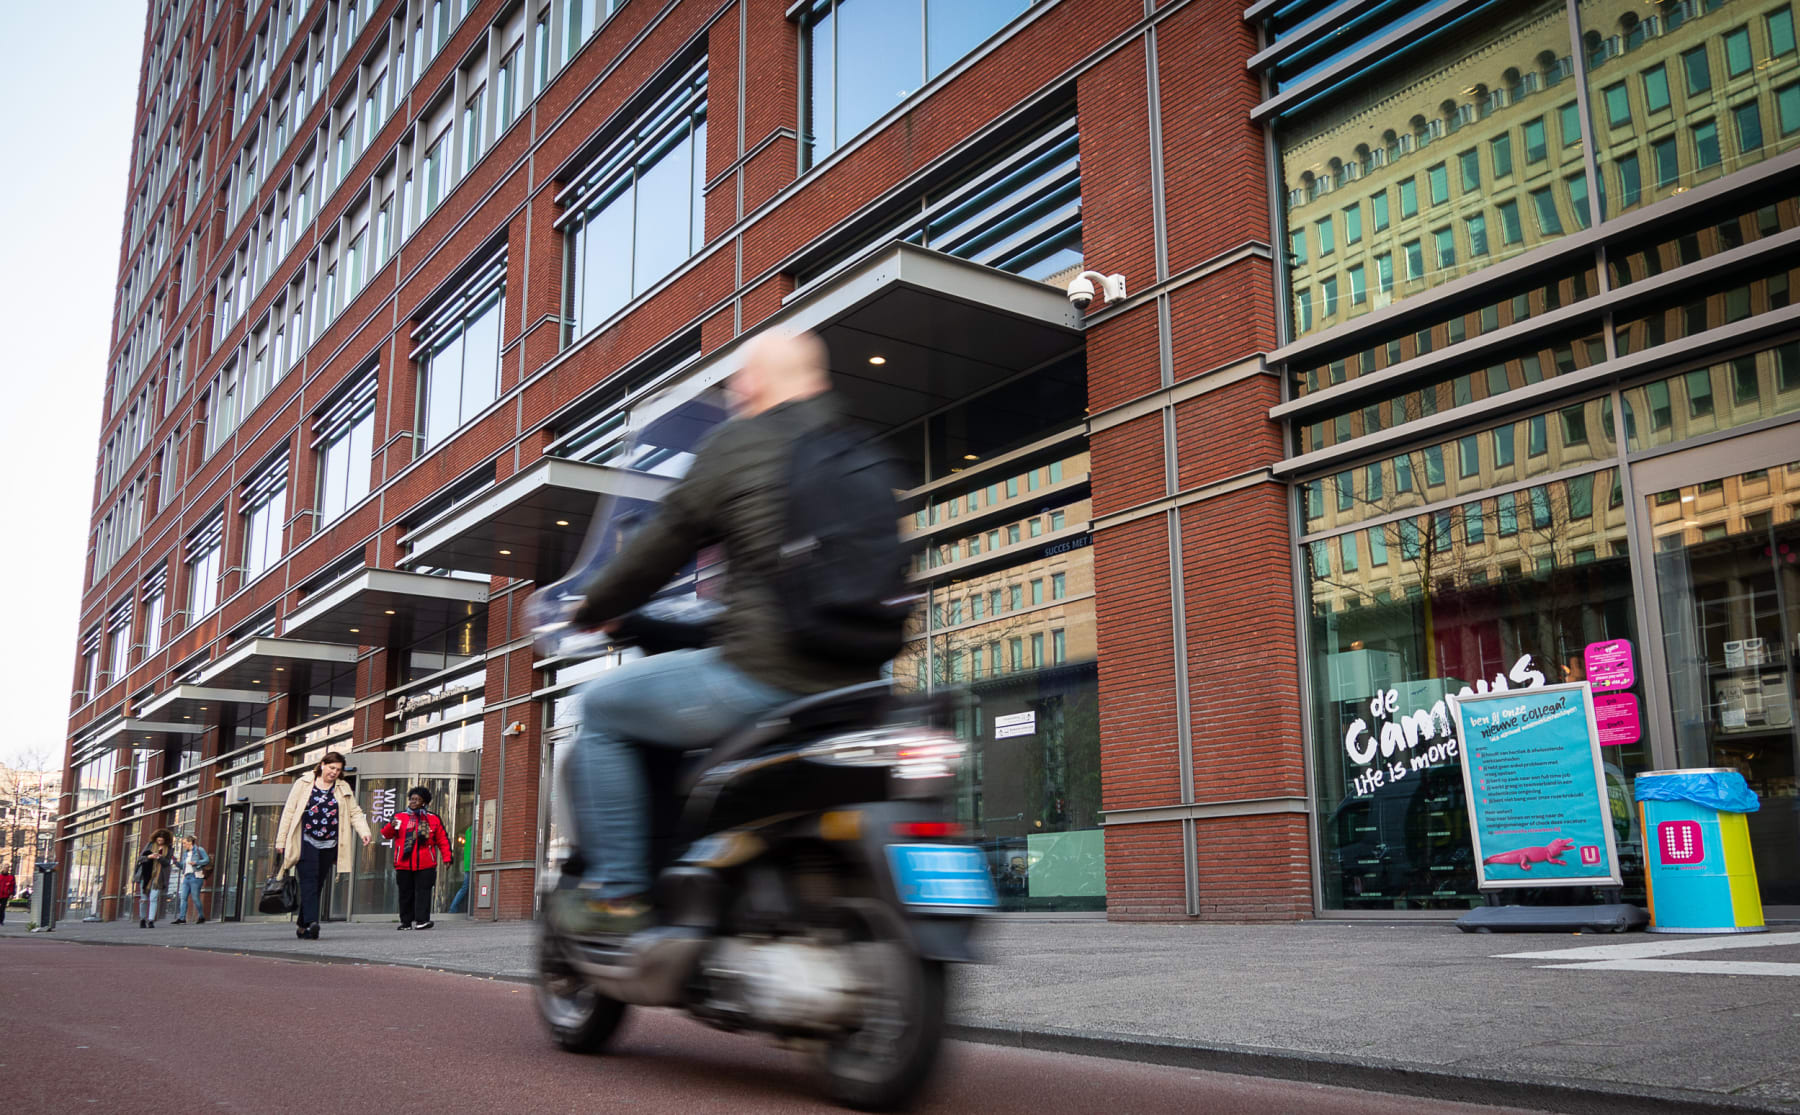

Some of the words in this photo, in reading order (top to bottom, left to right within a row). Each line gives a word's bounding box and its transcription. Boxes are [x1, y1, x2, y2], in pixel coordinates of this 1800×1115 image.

[1044, 542, 1070, 556] SUCCES
[1072, 536, 1088, 549] MET
[1370, 688, 1399, 720] de
[1470, 716, 1489, 727] ben
[1502, 705, 1526, 718] onze
[1481, 716, 1518, 739] nieuwe
[1522, 696, 1566, 722] collega?
[1387, 762, 1406, 782] is
[1410, 738, 1458, 772] more
[372, 789, 384, 824] HUIS
[1584, 848, 1596, 862] U
[1666, 826, 1693, 859] U
